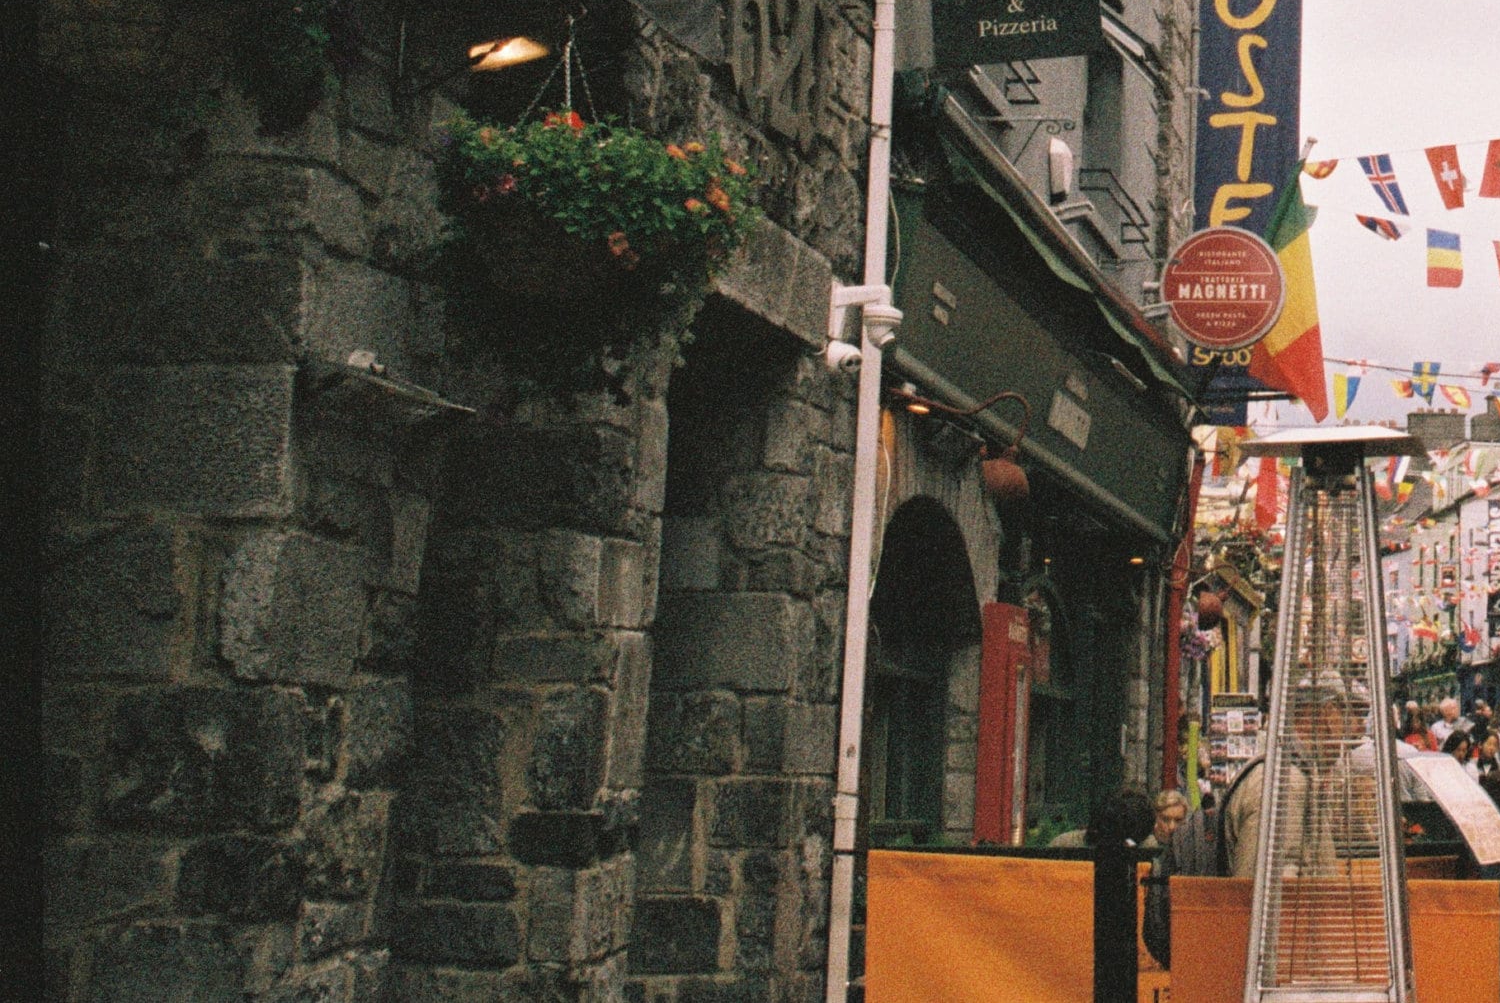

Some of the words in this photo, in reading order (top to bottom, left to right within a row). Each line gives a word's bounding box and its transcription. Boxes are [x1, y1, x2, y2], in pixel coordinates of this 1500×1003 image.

[978, 14, 1058, 37] Pizzeria
[1200, 275, 1245, 284] TRATTORIA
[1178, 283, 1267, 300] MAGNETTI
